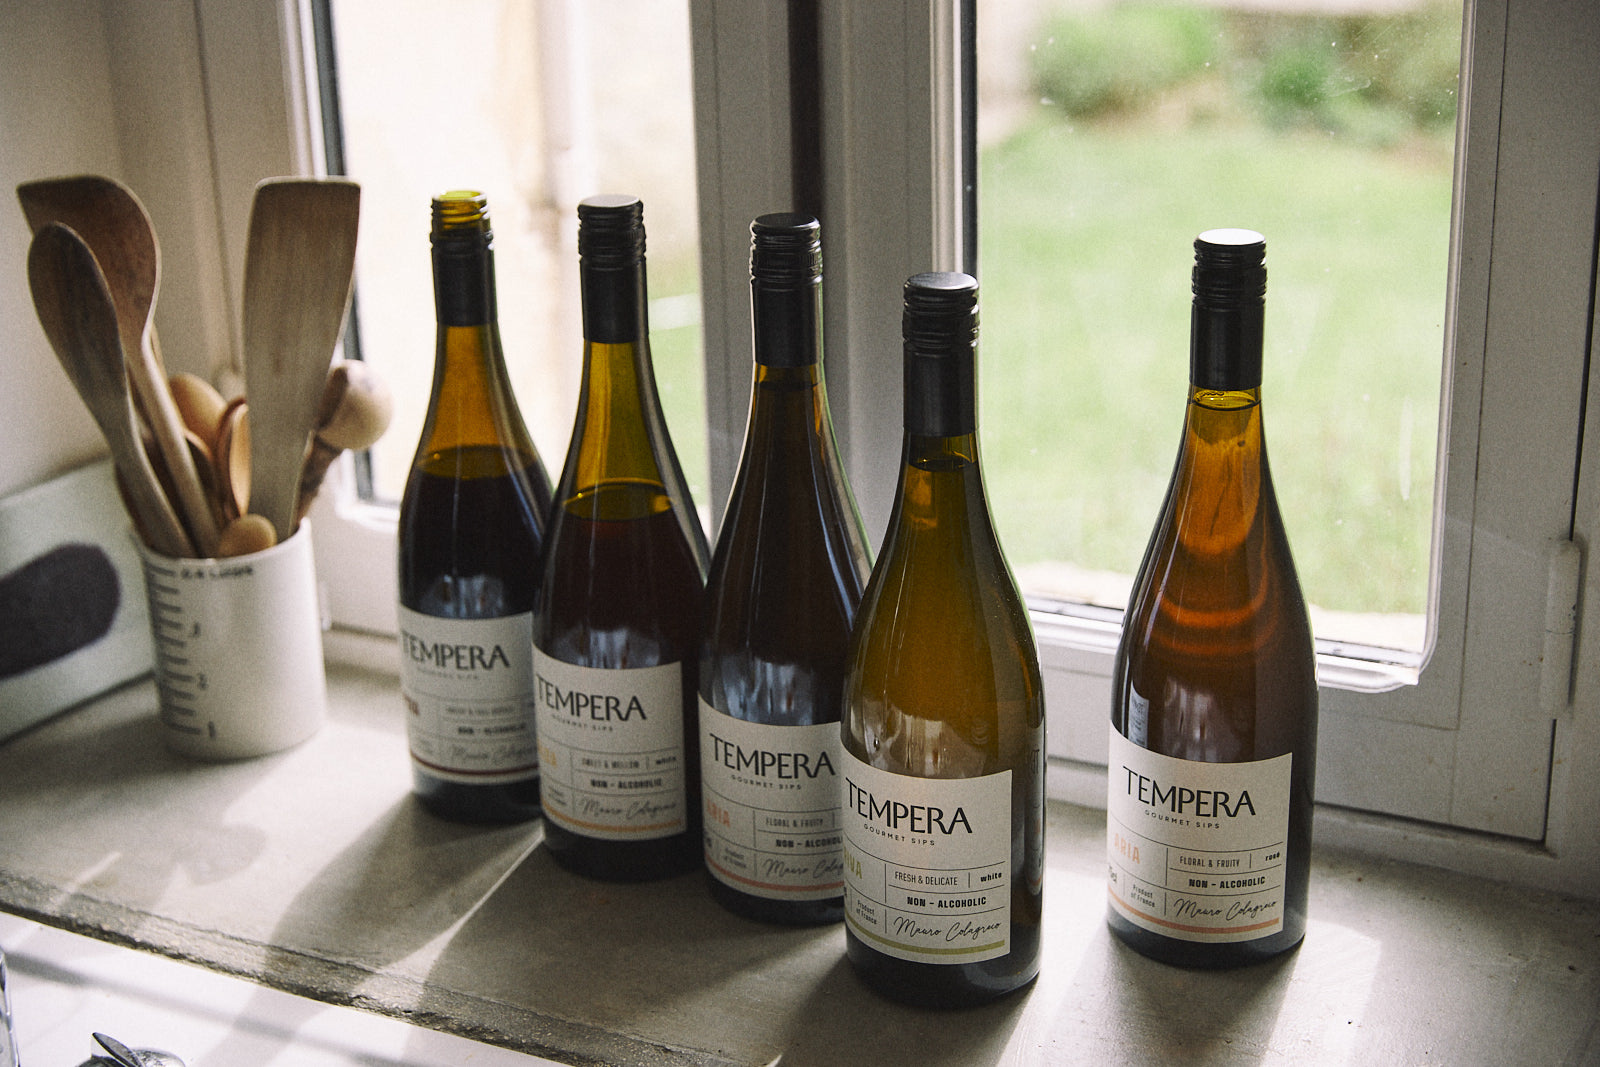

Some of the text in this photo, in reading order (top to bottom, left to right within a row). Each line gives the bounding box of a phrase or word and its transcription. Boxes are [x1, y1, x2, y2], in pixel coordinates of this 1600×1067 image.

[401, 629, 511, 670] TEMPERA
[536, 673, 647, 721] TEMPERA
[709, 732, 836, 779] TEMPERA
[731, 774, 774, 789] GOURMET
[1122, 765, 1256, 818] TEMPERA
[845, 777, 973, 835] TEMPERA
[1144, 809, 1220, 829] GOURMET SIPS
[776, 838, 794, 848] NON
[805, 835, 843, 848] ALCOHOLI
[863, 823, 935, 846] GOURMET SIPS
[1114, 833, 1140, 864] ARIA
[1179, 855, 1205, 867] FLORAL
[1208, 859, 1213, 868] &
[1216, 858, 1240, 868] FRUITY
[894, 871, 1003, 886] FRESH & DELICATE white
[1188, 878, 1208, 889] NON
[1219, 876, 1266, 889] ALCOHOLIC
[907, 896, 926, 907] NON
[937, 896, 987, 909] ALCOHOLIC
[1173, 898, 1222, 918] Mauro
[893, 916, 942, 937] Mauro
